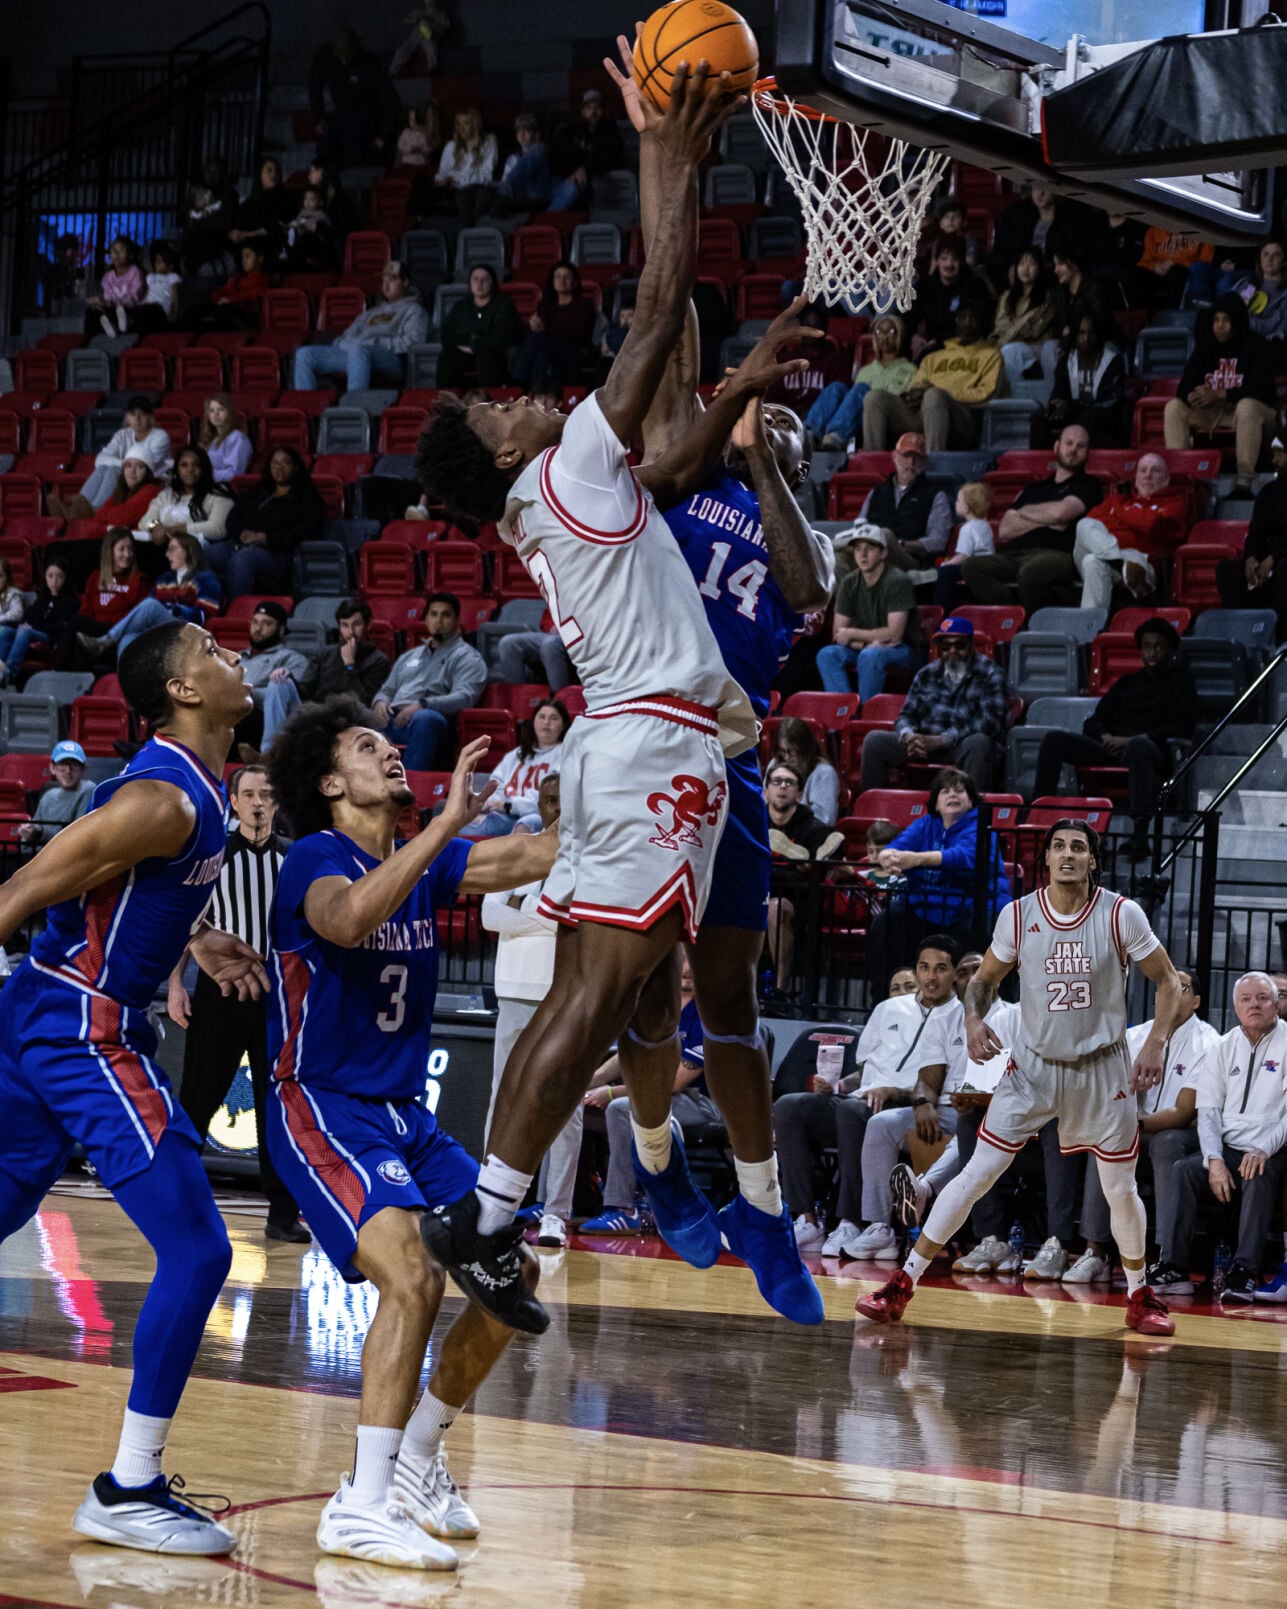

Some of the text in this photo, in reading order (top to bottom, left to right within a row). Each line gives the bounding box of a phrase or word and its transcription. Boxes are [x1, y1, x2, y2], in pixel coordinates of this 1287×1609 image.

[687, 494, 768, 553] LOUISIAN
[699, 542, 768, 621] 14
[1045, 957, 1092, 975] STATE
[1053, 941, 1083, 959] JAX
[376, 964, 408, 1032] 3
[1047, 980, 1092, 1012] 23
